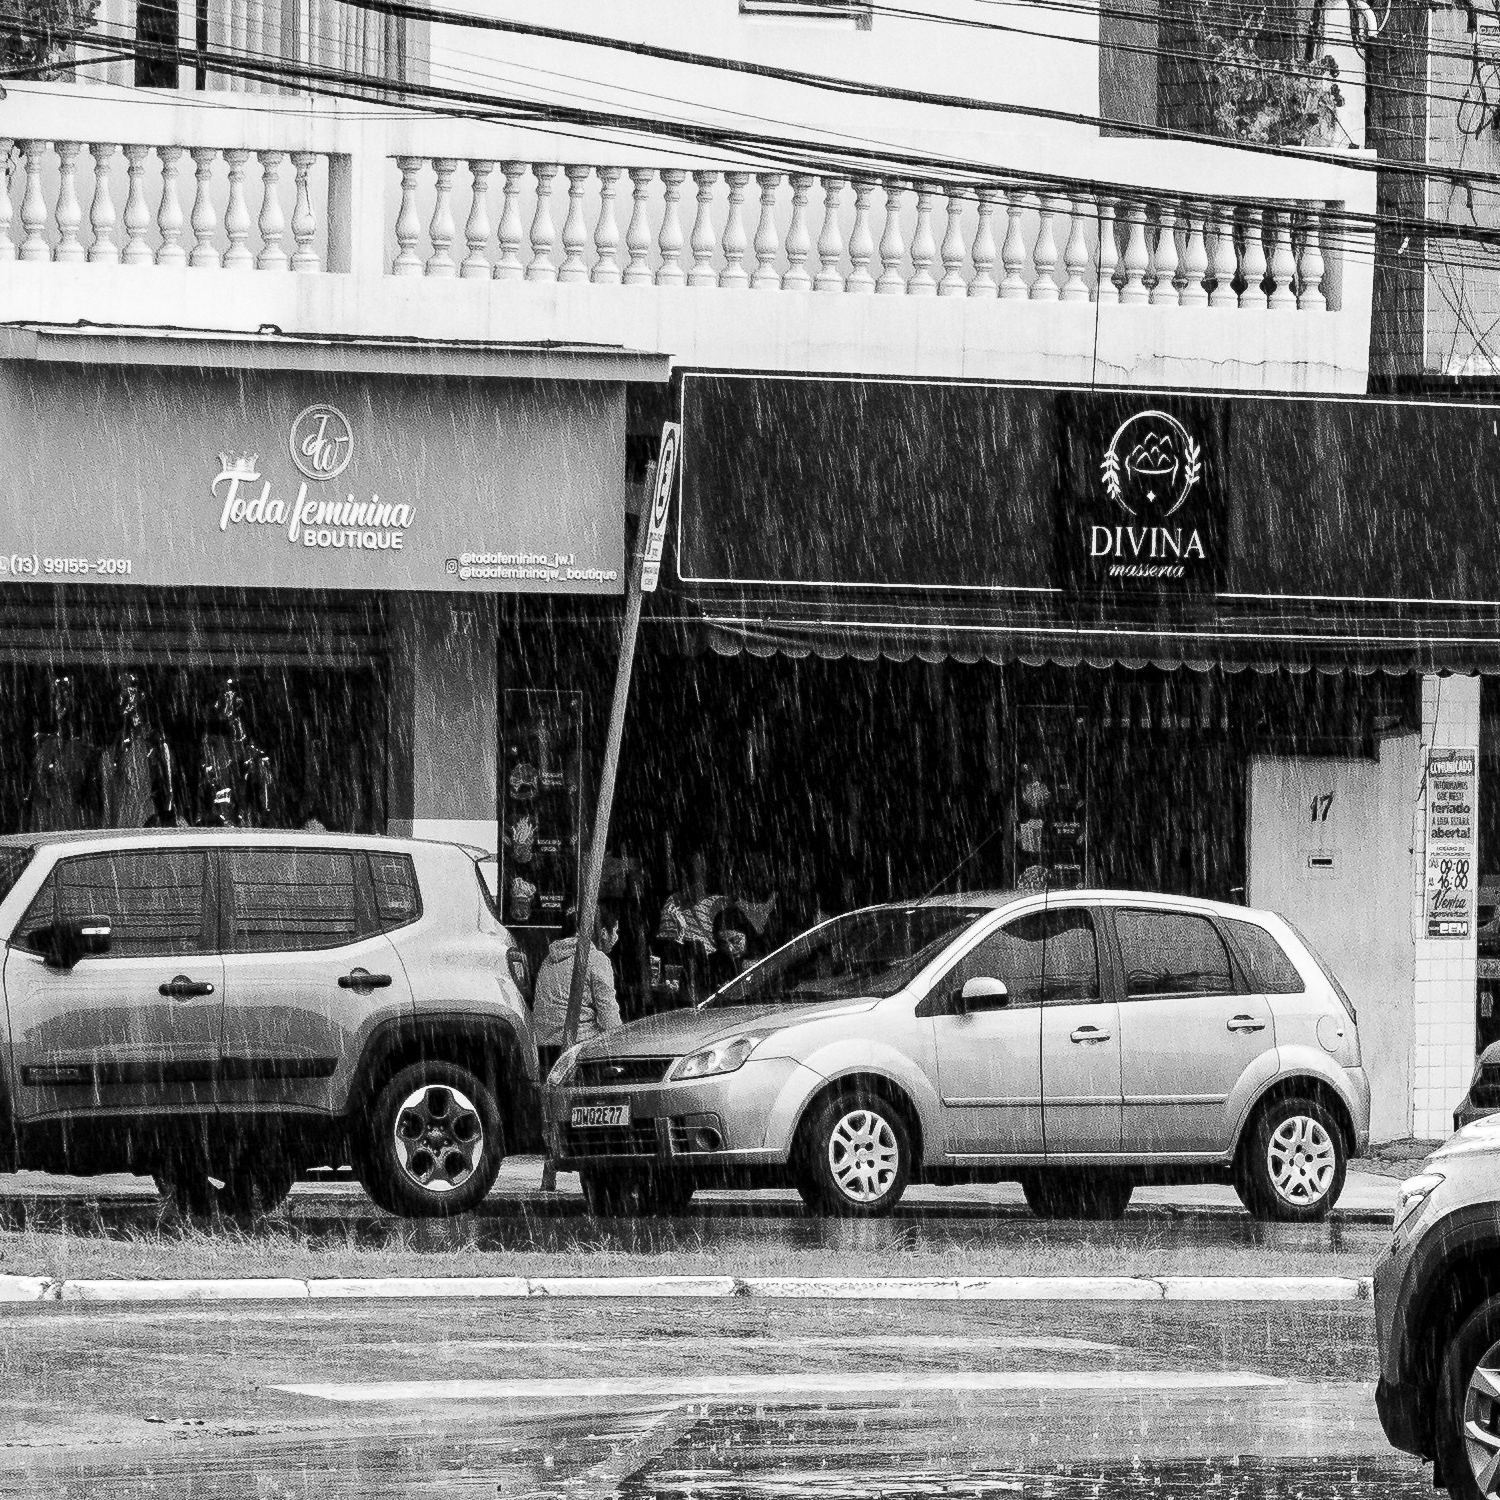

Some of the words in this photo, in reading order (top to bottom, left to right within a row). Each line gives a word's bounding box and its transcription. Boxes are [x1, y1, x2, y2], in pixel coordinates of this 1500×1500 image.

[211, 470, 289, 531] Toda
[288, 481, 416, 543] feminina
[303, 530, 404, 550] BOUTIQUE
[1089, 525, 1206, 559] DIVINA
[10, 554, 40, 576] (13)
[43, 557, 132, 575] 99155-2091
[1108, 561, 1186, 578] masseria
[1308, 793, 1334, 823] 17
[1431, 801, 1471, 814] feriado
[1430, 827, 1472, 839] aberta!
[1432, 887, 1467, 910] Venha
